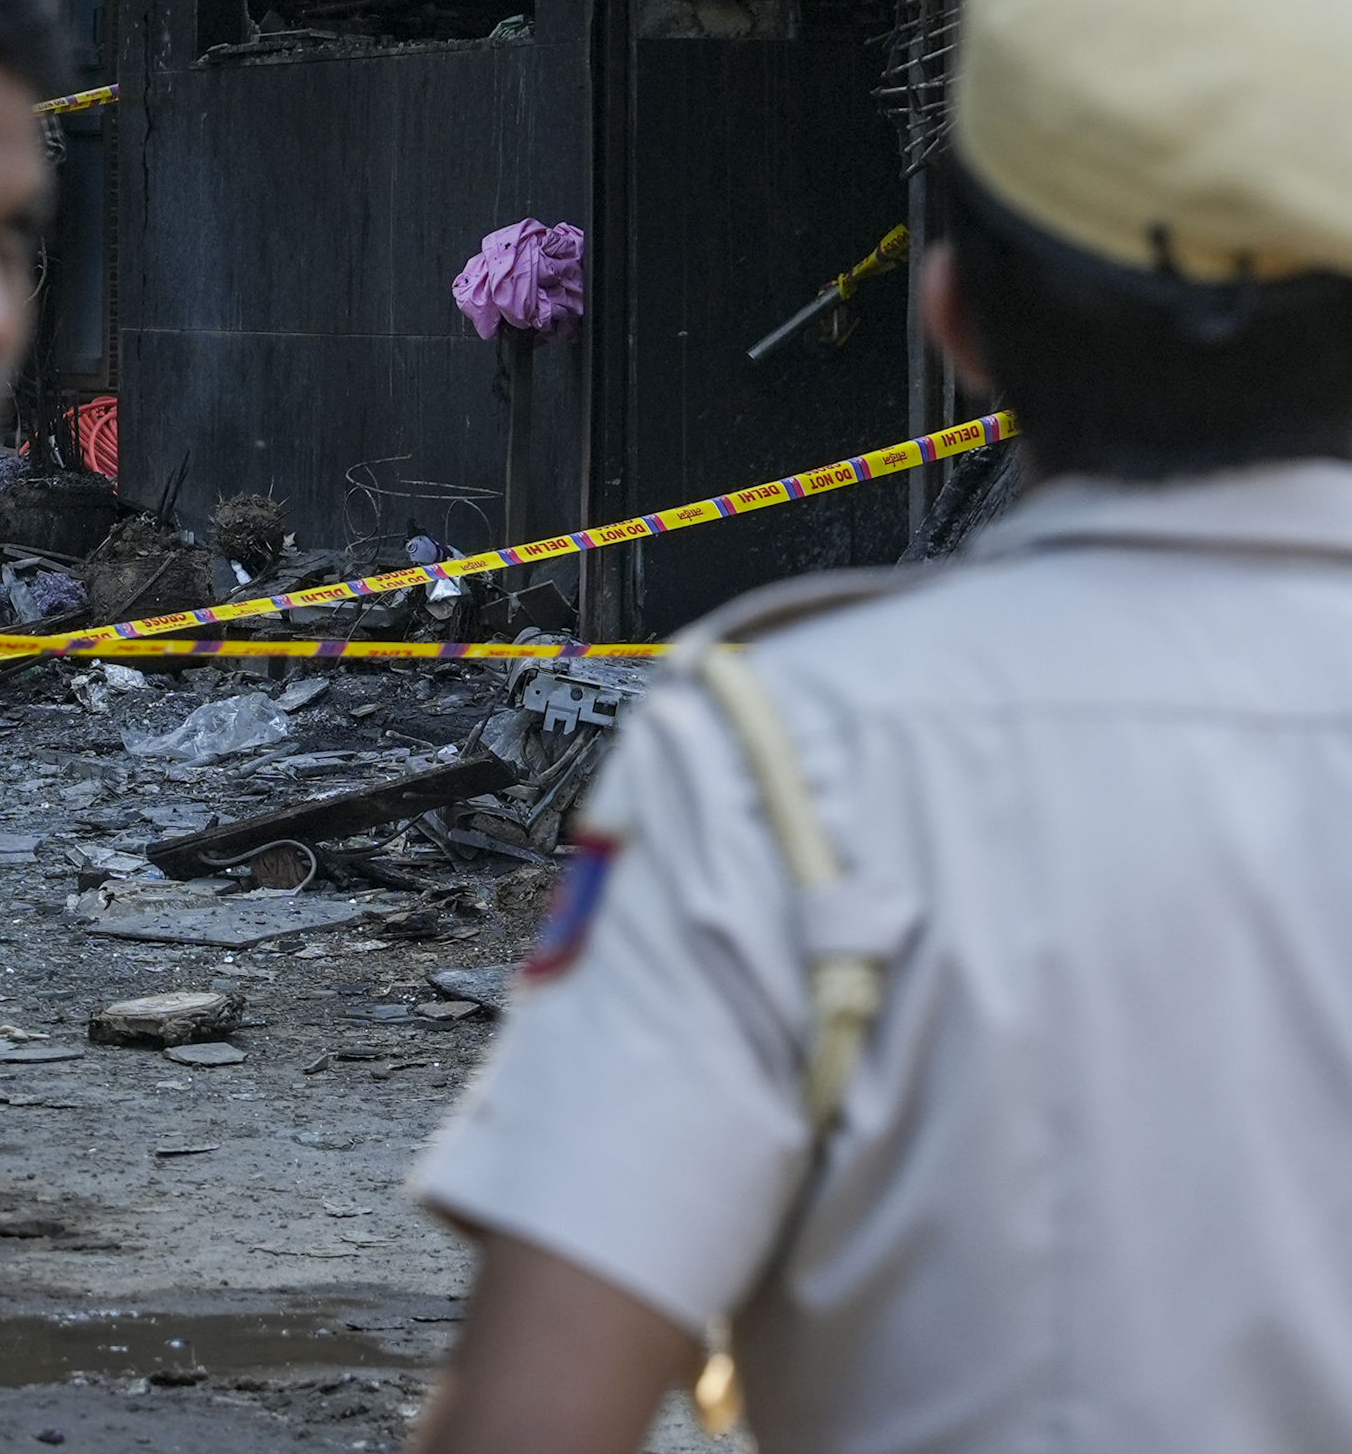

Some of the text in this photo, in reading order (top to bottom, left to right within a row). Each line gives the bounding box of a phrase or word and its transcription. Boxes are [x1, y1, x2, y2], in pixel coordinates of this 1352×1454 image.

[940, 424, 980, 448] DELHI
[809, 472, 834, 490] NOT
[834, 467, 853, 483] DO
[737, 484, 781, 504] DELHI
[599, 527, 625, 543] NOT
[626, 523, 647, 537] DO
[523, 537, 570, 556] DELHI
[142, 612, 187, 628] CROSS
